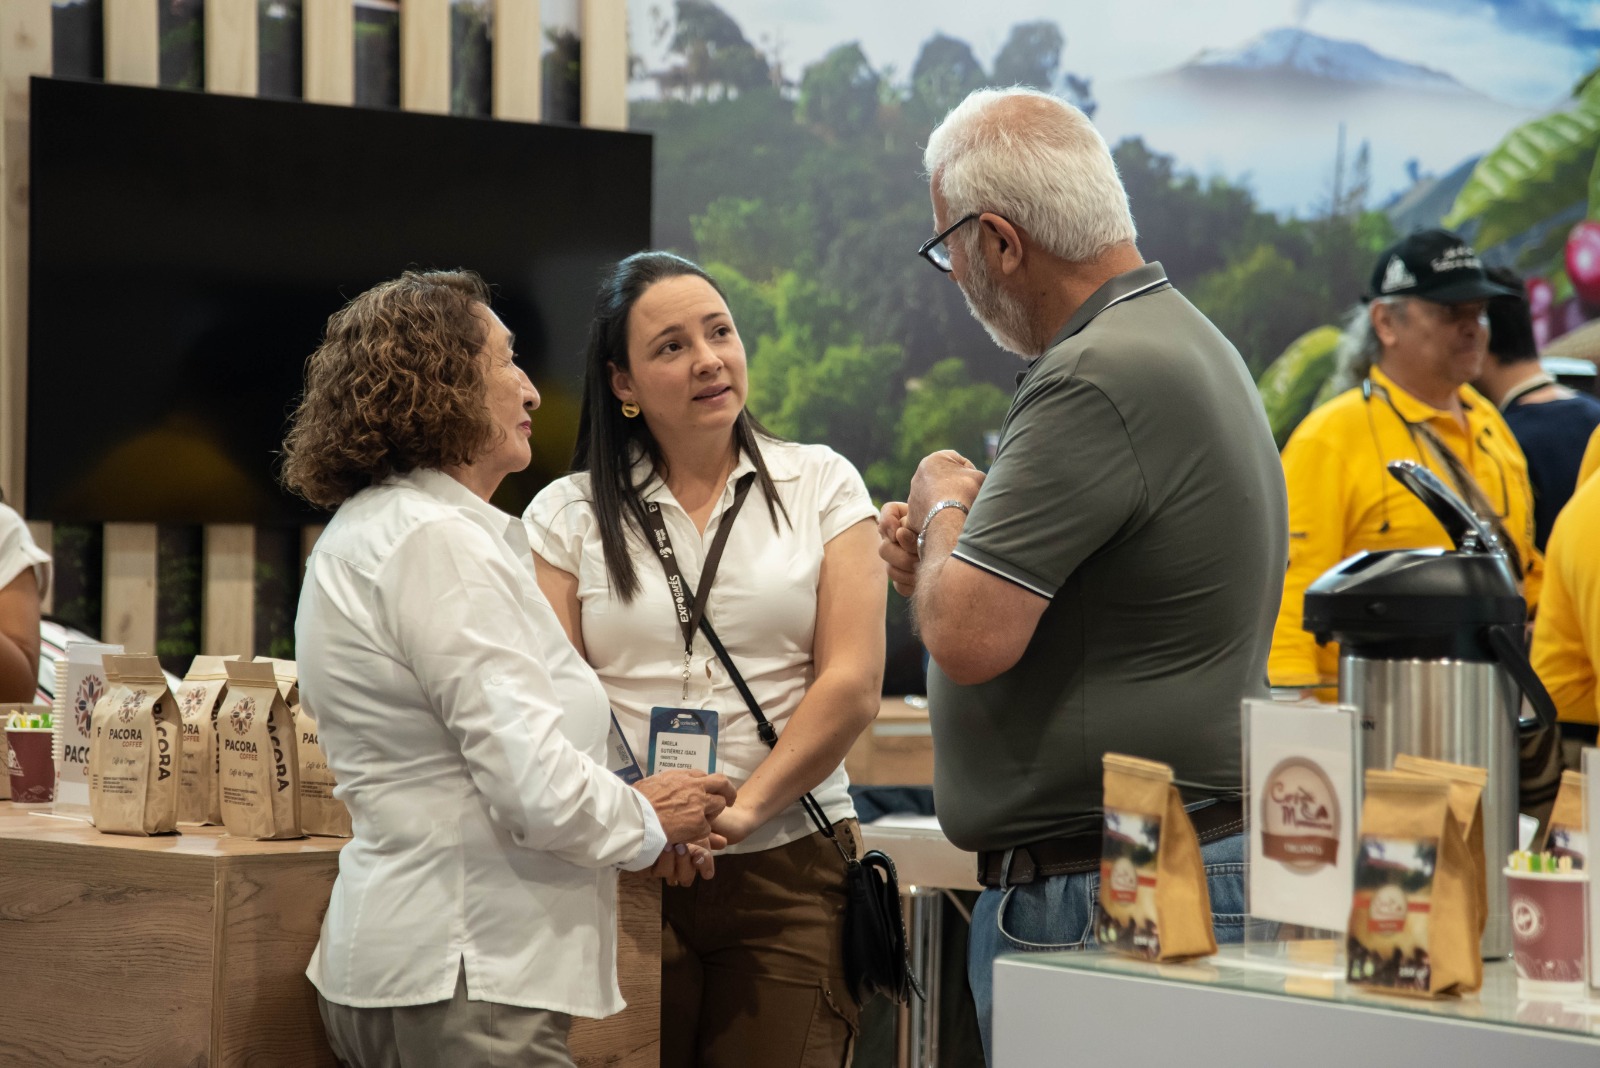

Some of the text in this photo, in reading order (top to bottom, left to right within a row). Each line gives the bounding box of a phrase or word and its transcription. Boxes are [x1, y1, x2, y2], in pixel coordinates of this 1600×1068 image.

[109, 728, 143, 740] PACORA
[225, 739, 258, 753] PACORA
[240, 753, 258, 761] COFFEE
